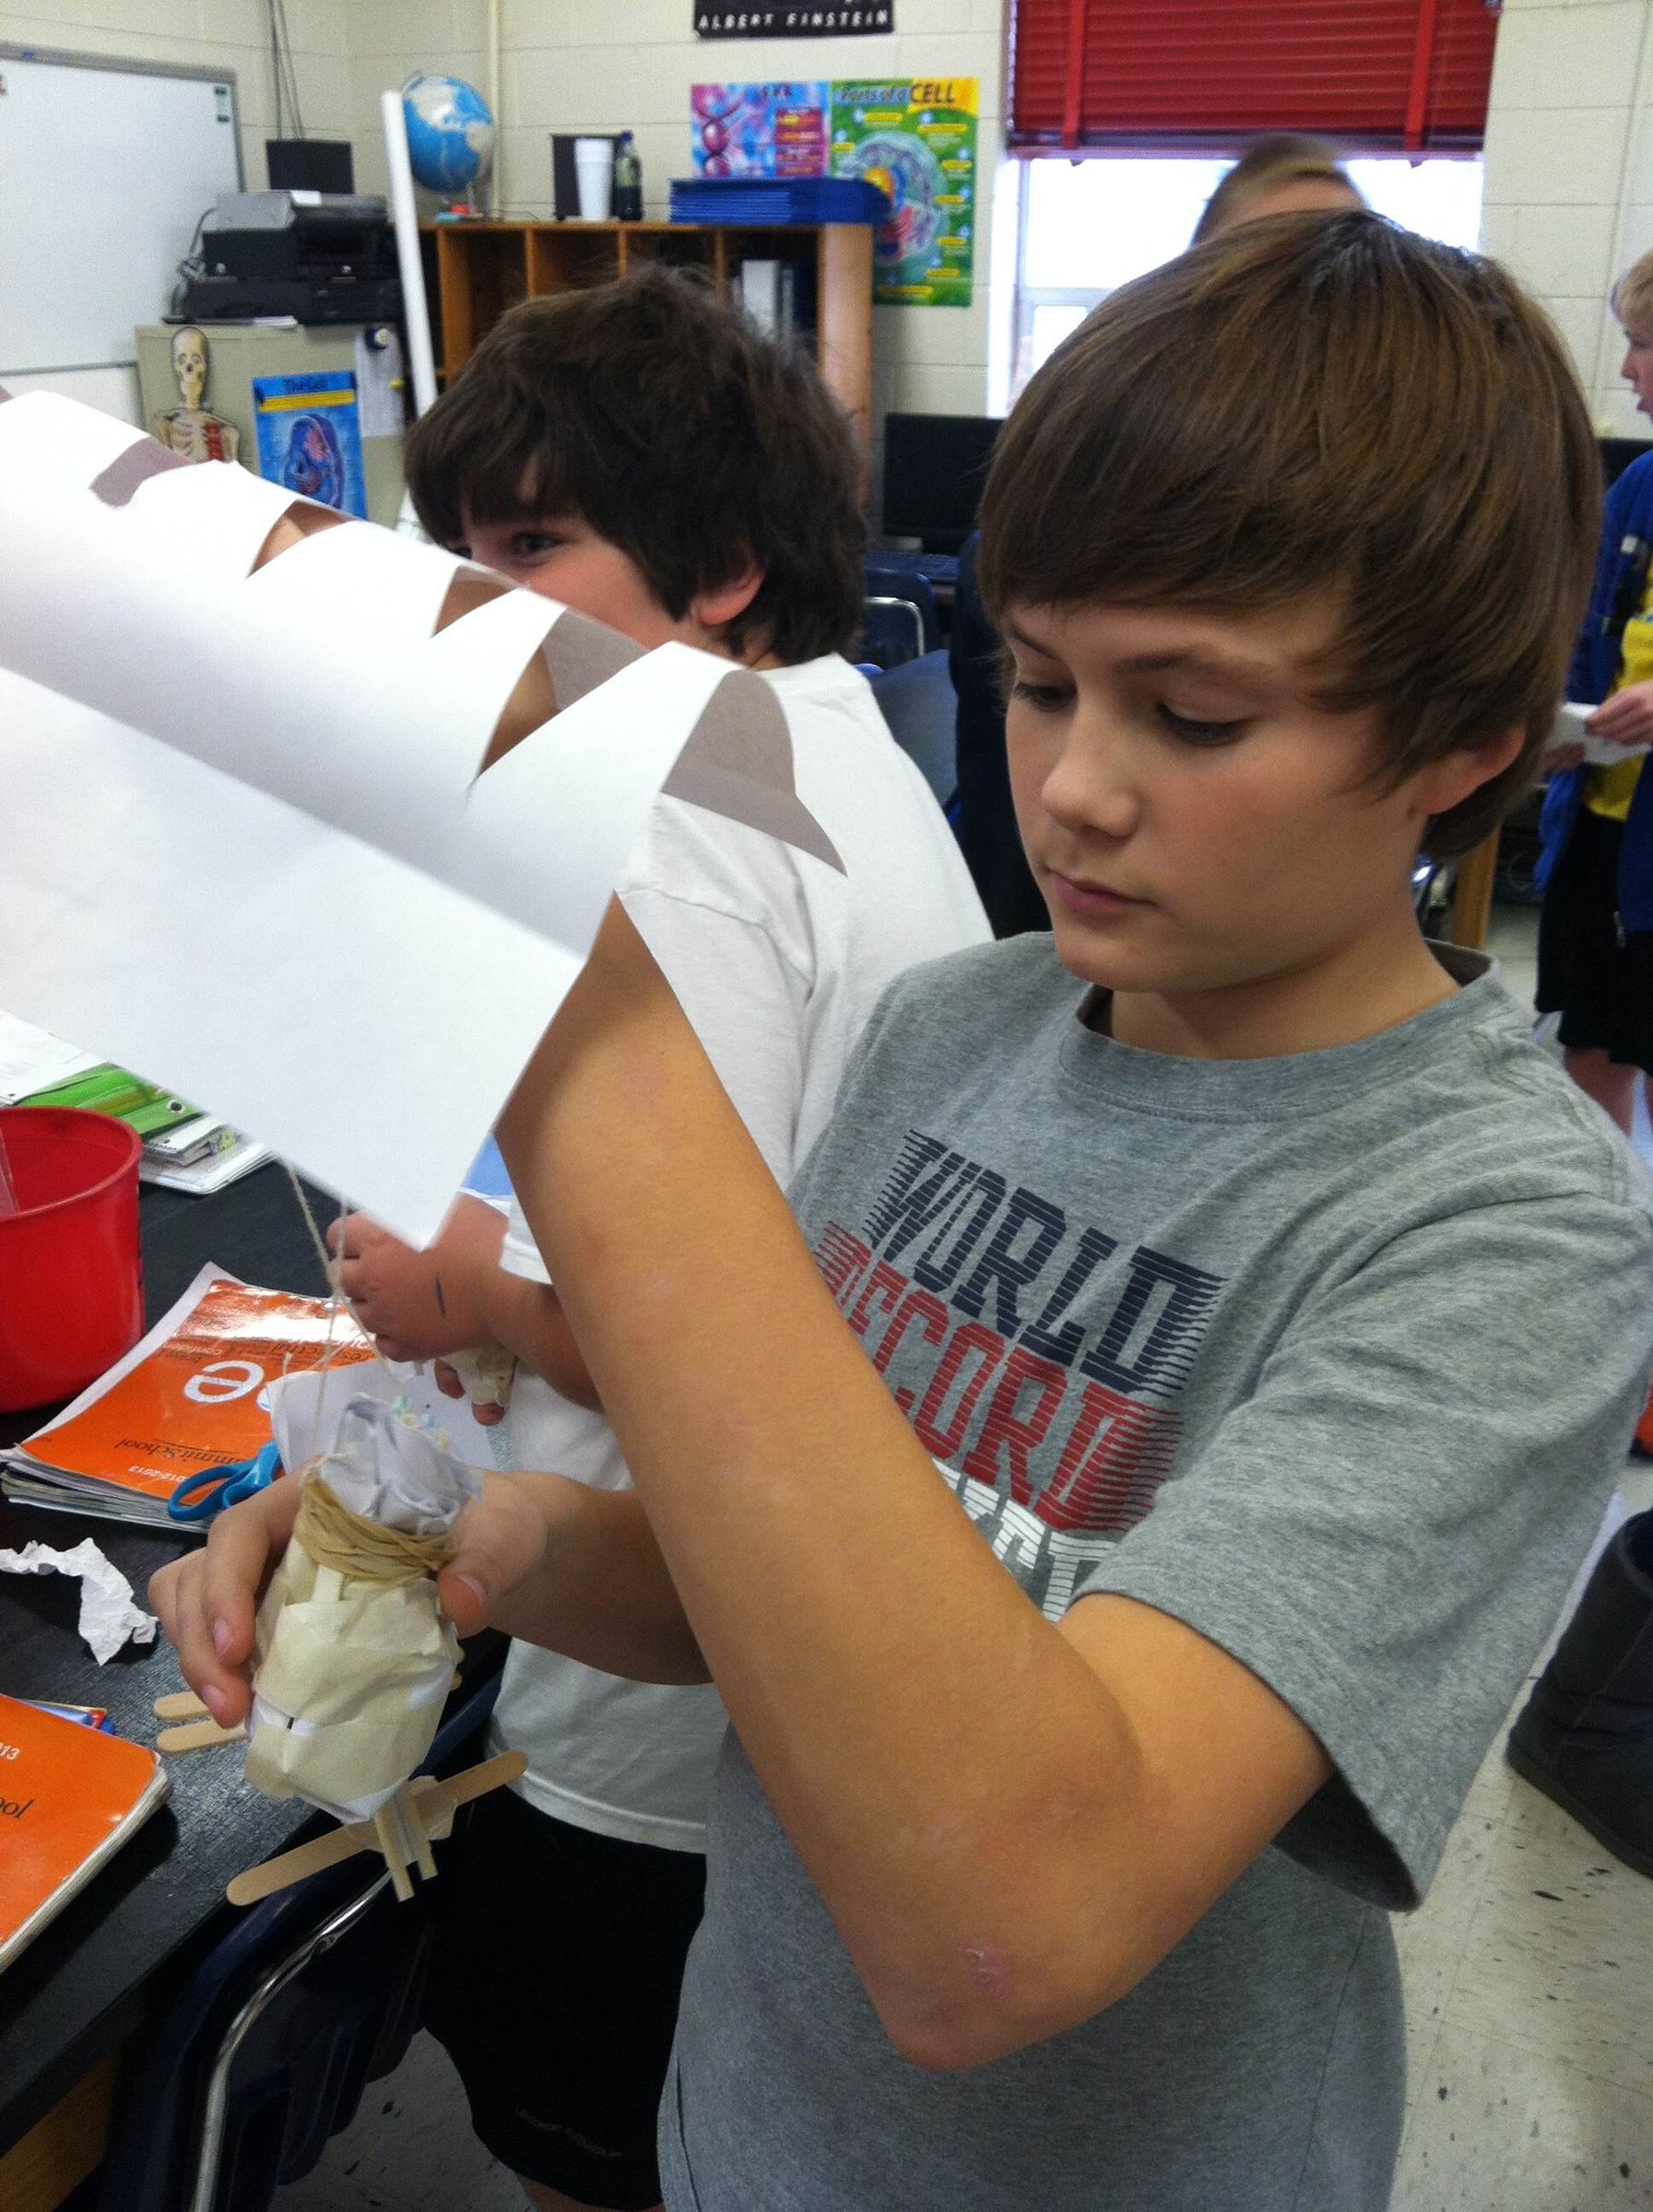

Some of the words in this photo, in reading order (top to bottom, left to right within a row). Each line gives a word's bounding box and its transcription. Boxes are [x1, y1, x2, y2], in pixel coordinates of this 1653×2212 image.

[697, 13, 774, 30] ALBERT
[785, 9, 890, 28] EINSTEIN
[910, 82, 955, 104] CELL
[862, 1128, 1232, 1398] WORLD
[127, 1465, 187, 1483] 012-2013
